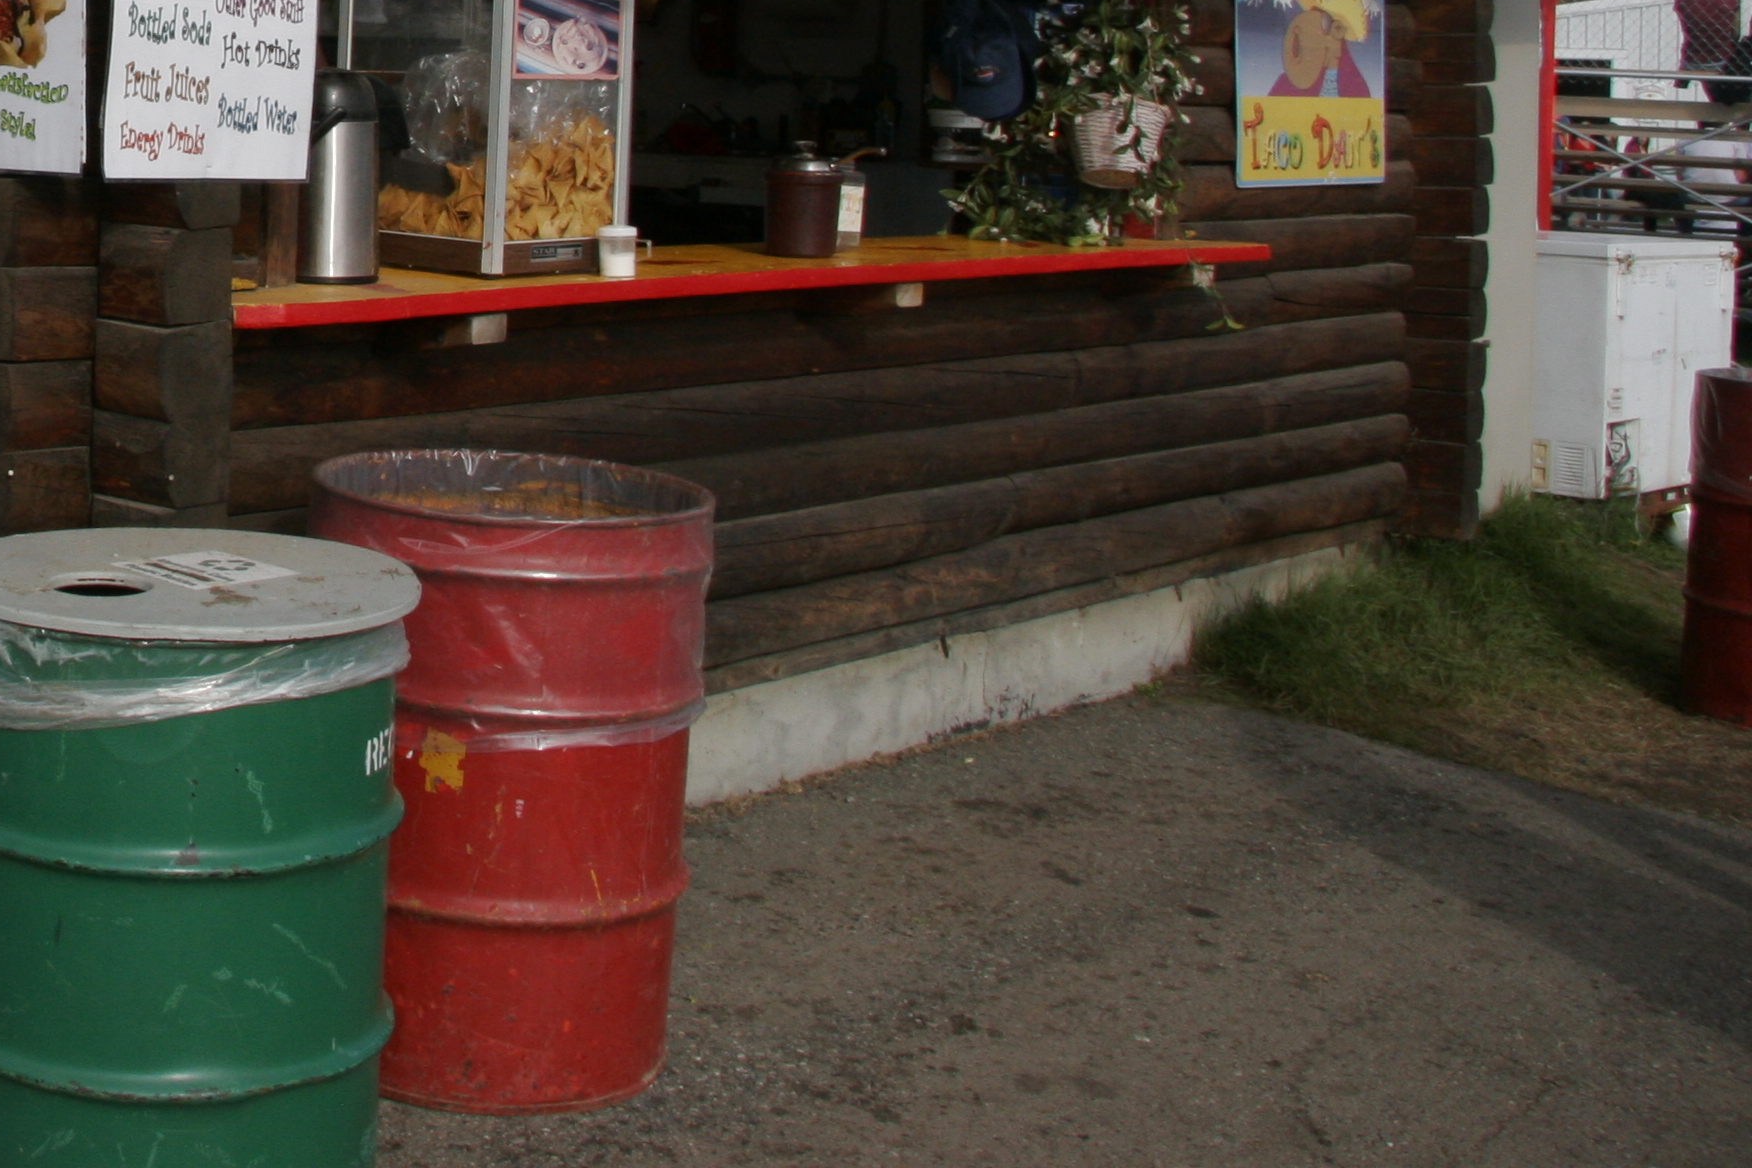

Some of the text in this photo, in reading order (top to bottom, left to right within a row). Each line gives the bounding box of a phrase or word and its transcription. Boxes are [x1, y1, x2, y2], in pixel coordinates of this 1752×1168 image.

[127, 0, 213, 47] Bottled Soda
[220, 31, 301, 71] Hot Drinks
[123, 60, 211, 105] Fruit Juices
[217, 92, 298, 136] Bottled Water
[1243, 102, 1304, 170] TACO
[120, 120, 206, 162] Energy Drinks
